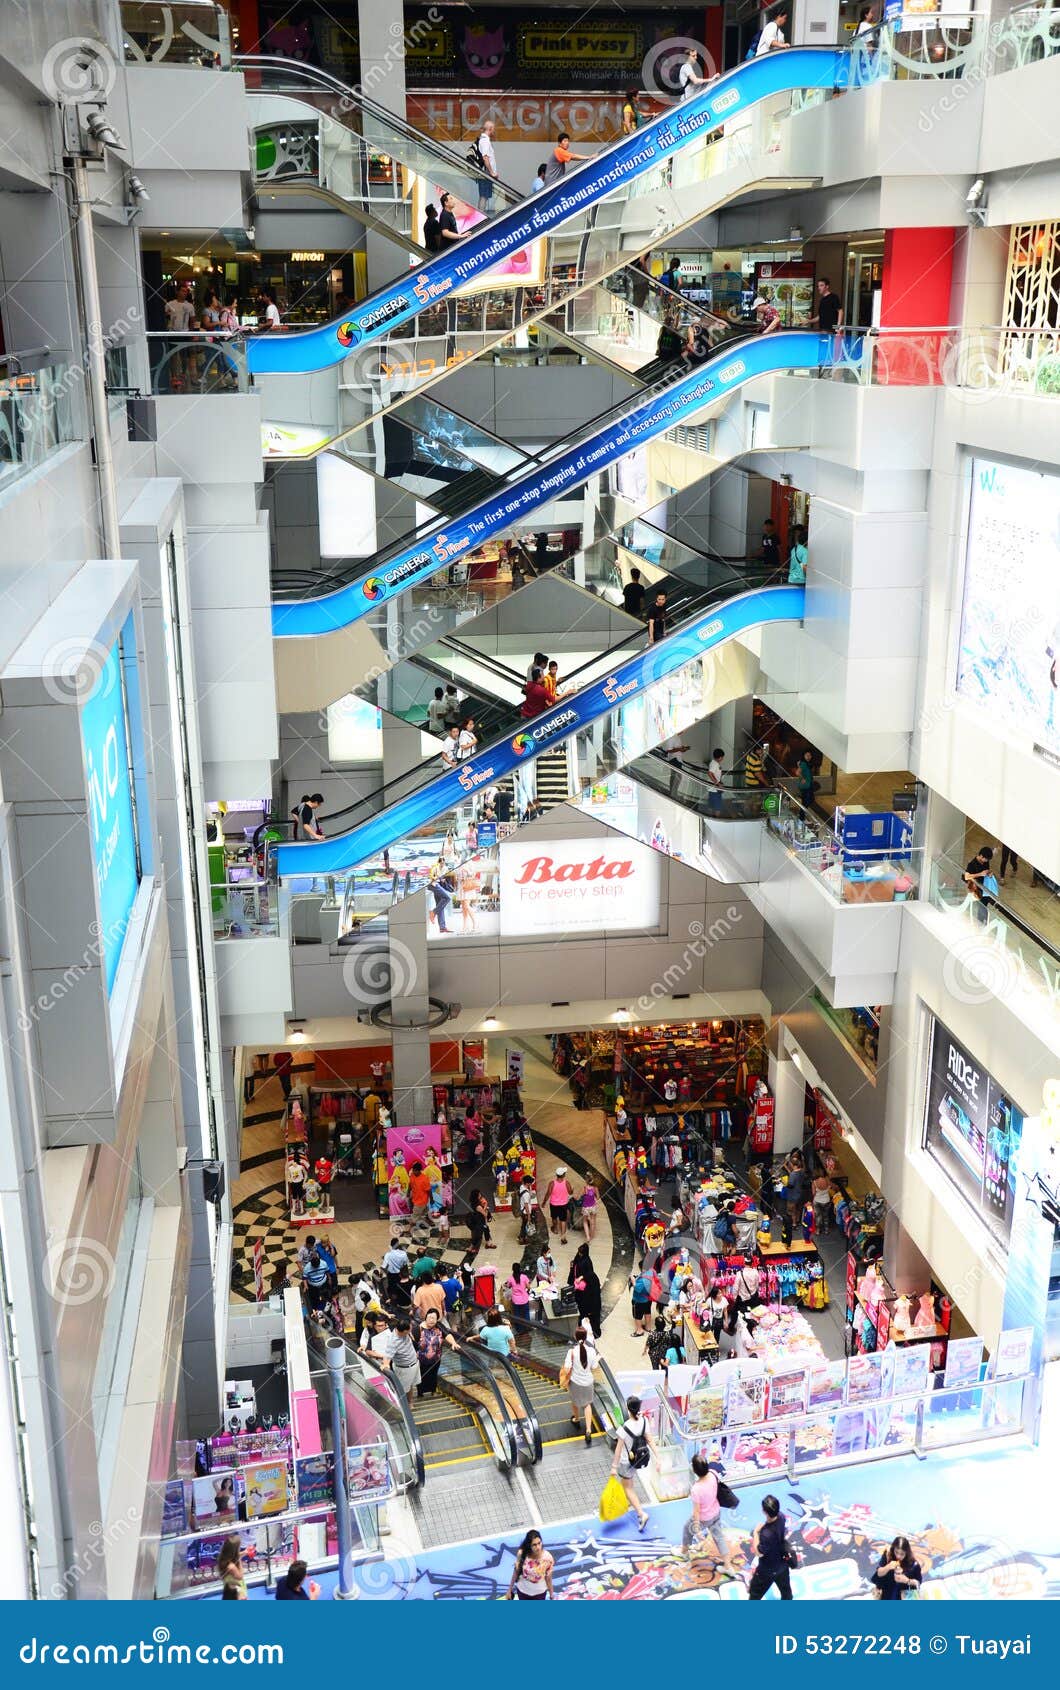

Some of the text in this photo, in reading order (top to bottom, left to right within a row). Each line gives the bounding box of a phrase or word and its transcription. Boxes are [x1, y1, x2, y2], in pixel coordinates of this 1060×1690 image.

[531, 35, 572, 51] Pink
[570, 71, 612, 80] Wholesale
[620, 71, 642, 80] Retai
[427, 99, 649, 132] HONGKON
[291, 253, 325, 262] Nikon
[359, 294, 410, 328] CAMERA
[468, 379, 715, 535] The first one-stop shopping of camera and accessory in Bangkok
[384, 552, 431, 583] CAMERA
[616, 679, 638, 698] Floor
[532, 709, 577, 739] CAMERA
[471, 767, 494, 786] Floor
[514, 855, 635, 884] Bata
[520, 887, 541, 900] For
[547, 886, 588, 900] every
[948, 1044, 980, 1100] RIDGE
